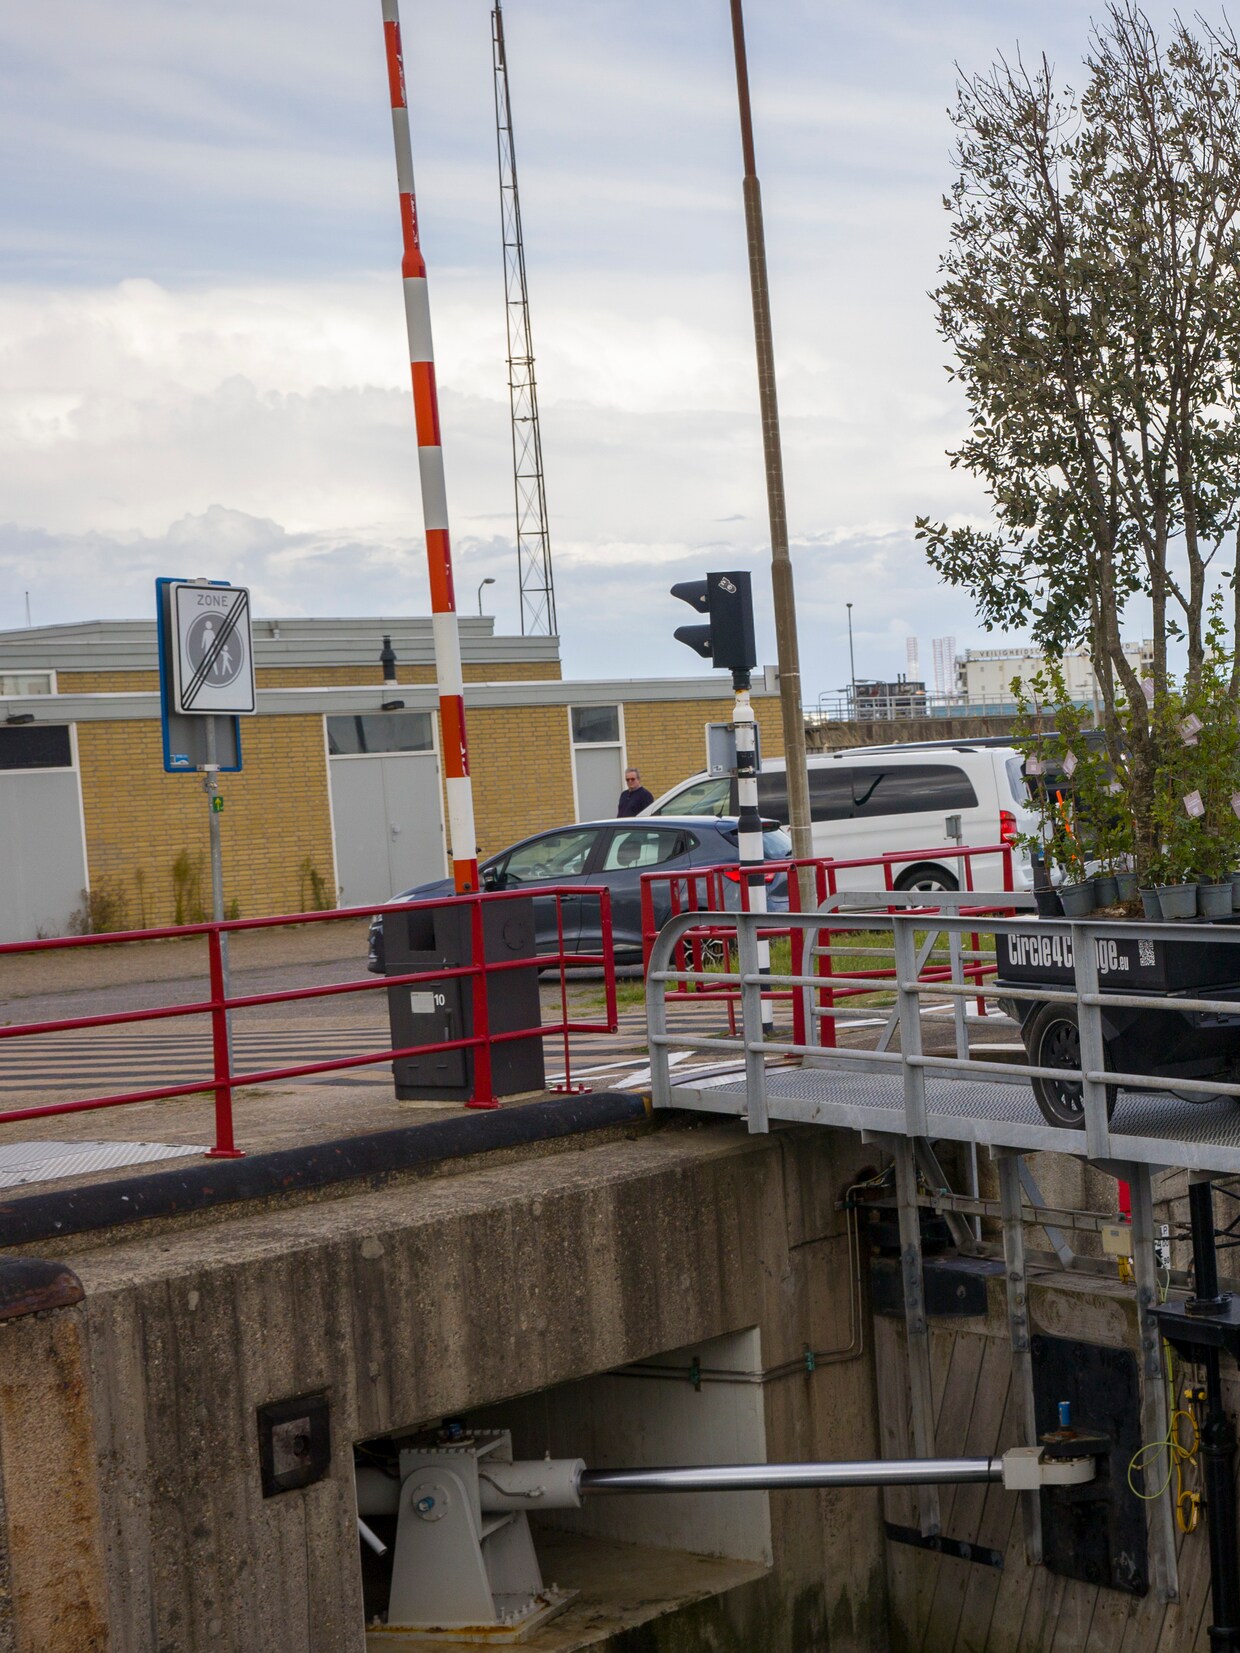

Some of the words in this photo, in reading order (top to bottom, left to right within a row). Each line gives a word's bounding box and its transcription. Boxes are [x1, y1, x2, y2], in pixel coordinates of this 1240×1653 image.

[197, 594, 229, 607] ZONE
[1007, 934, 1129, 974] Circle4Cge.eu
[434, 994, 446, 1006] 10
